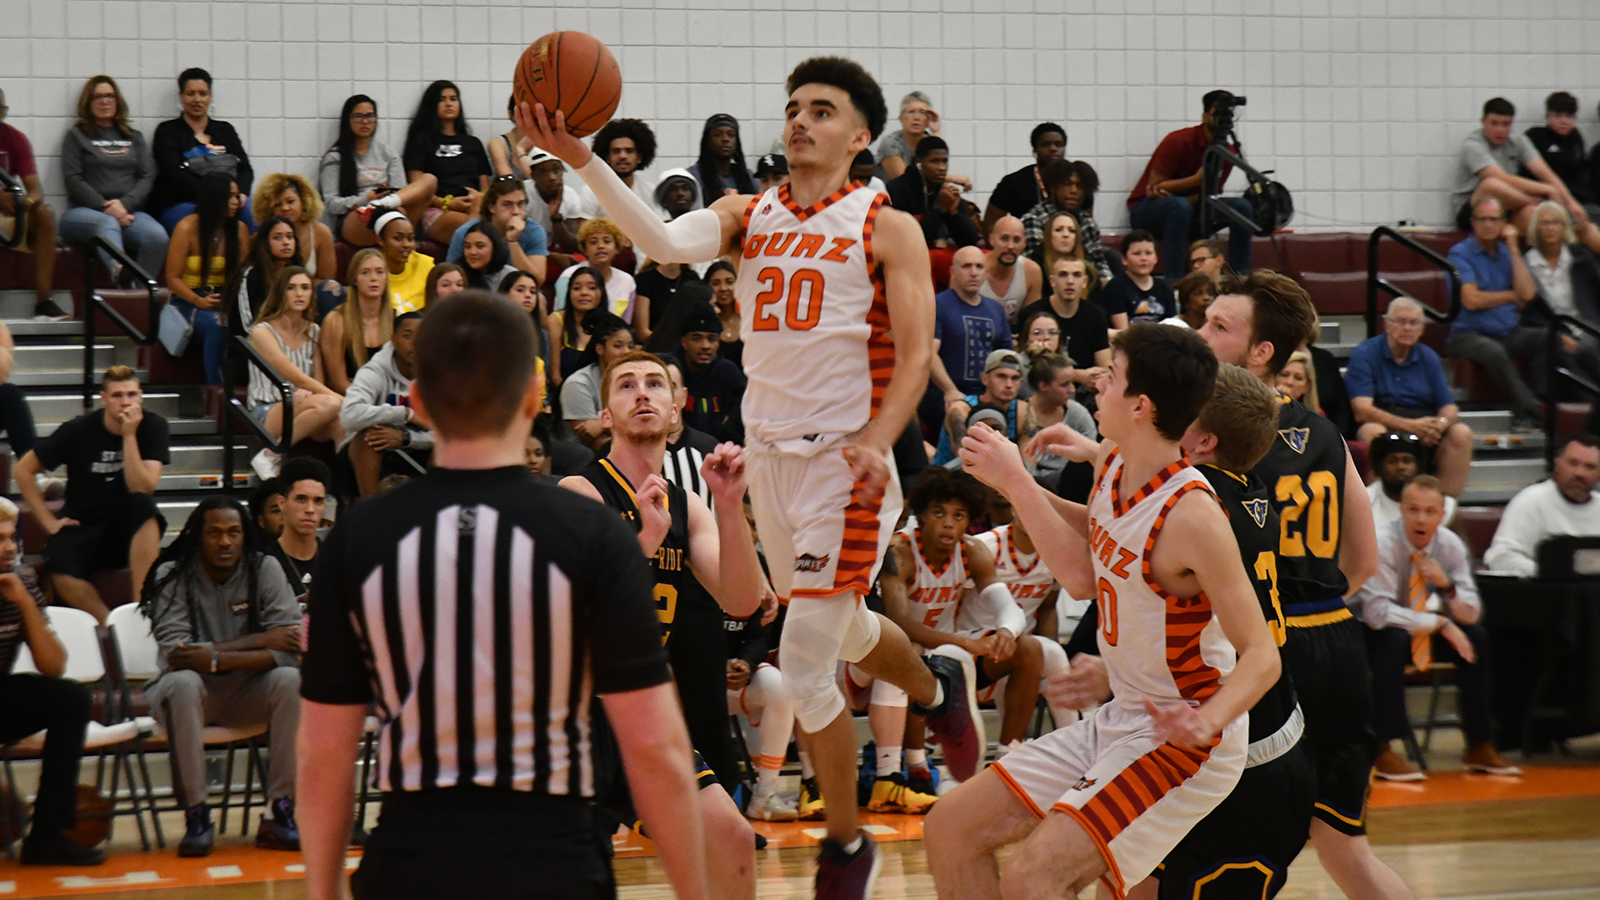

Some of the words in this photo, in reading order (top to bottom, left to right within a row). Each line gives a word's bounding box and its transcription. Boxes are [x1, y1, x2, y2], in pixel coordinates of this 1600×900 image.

[744, 232, 858, 263] OUAZ
[753, 267, 825, 332] 20
[1275, 470, 1339, 559] 20
